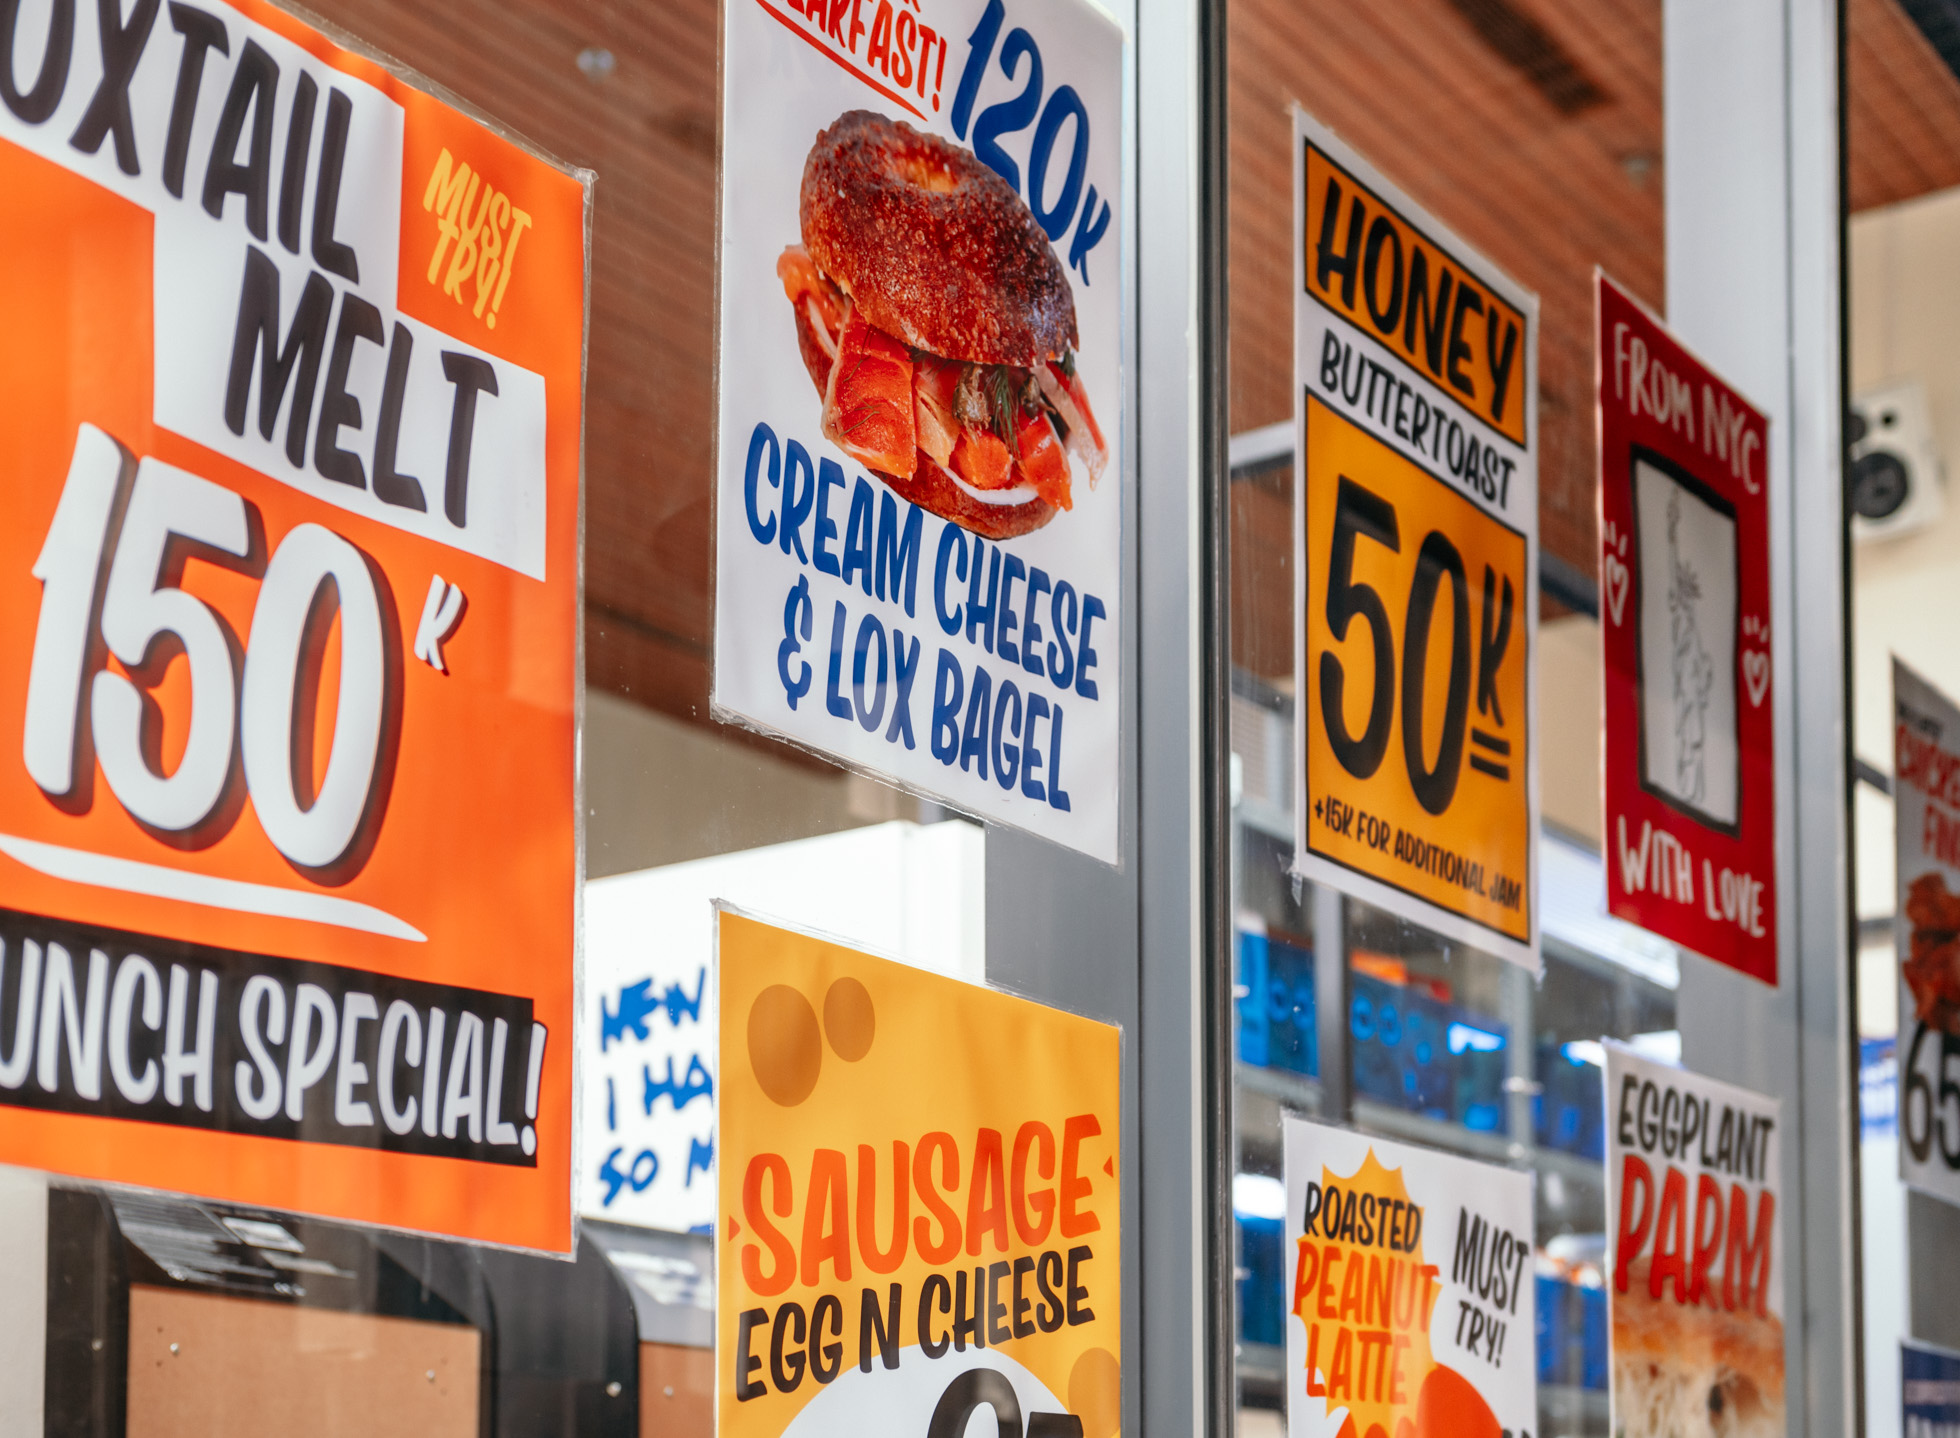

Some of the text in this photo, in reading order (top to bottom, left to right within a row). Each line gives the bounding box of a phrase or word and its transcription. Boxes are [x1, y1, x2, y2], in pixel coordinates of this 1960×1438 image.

[0, 0, 359, 285] OXTAIL
[423, 147, 532, 265] MUST
[427, 217, 511, 330] TRY!
[1317, 176, 1518, 423] HONEY
[224, 243, 499, 529] MELT
[1320, 328, 1516, 510] BUTTERTOAST
[1614, 321, 1761, 494] FROM NYC
[744, 422, 1106, 701] CREAM CHEESE
[778, 573, 1071, 812] & LOX BAGEL
[1315, 796, 1521, 913] +15K FOR ADDITIONAL JAM
[1618, 814, 1766, 938] WITH LOVE
[235, 975, 548, 1156] SPECIAL!
[1617, 1074, 1774, 1182] EGGPLANT
[741, 1114, 1102, 1297] SAUSAGE
[1304, 1181, 1422, 1254] ROASTED
[1452, 1206, 1529, 1316] MUST
[1615, 1154, 1775, 1319] PARM
[736, 1245, 1095, 1402] EGG N CHEESE
[1294, 1241, 1440, 1333] PEANUT
[1306, 1323, 1412, 1405] LATTE
[1456, 1300, 1507, 1368] TRY!
